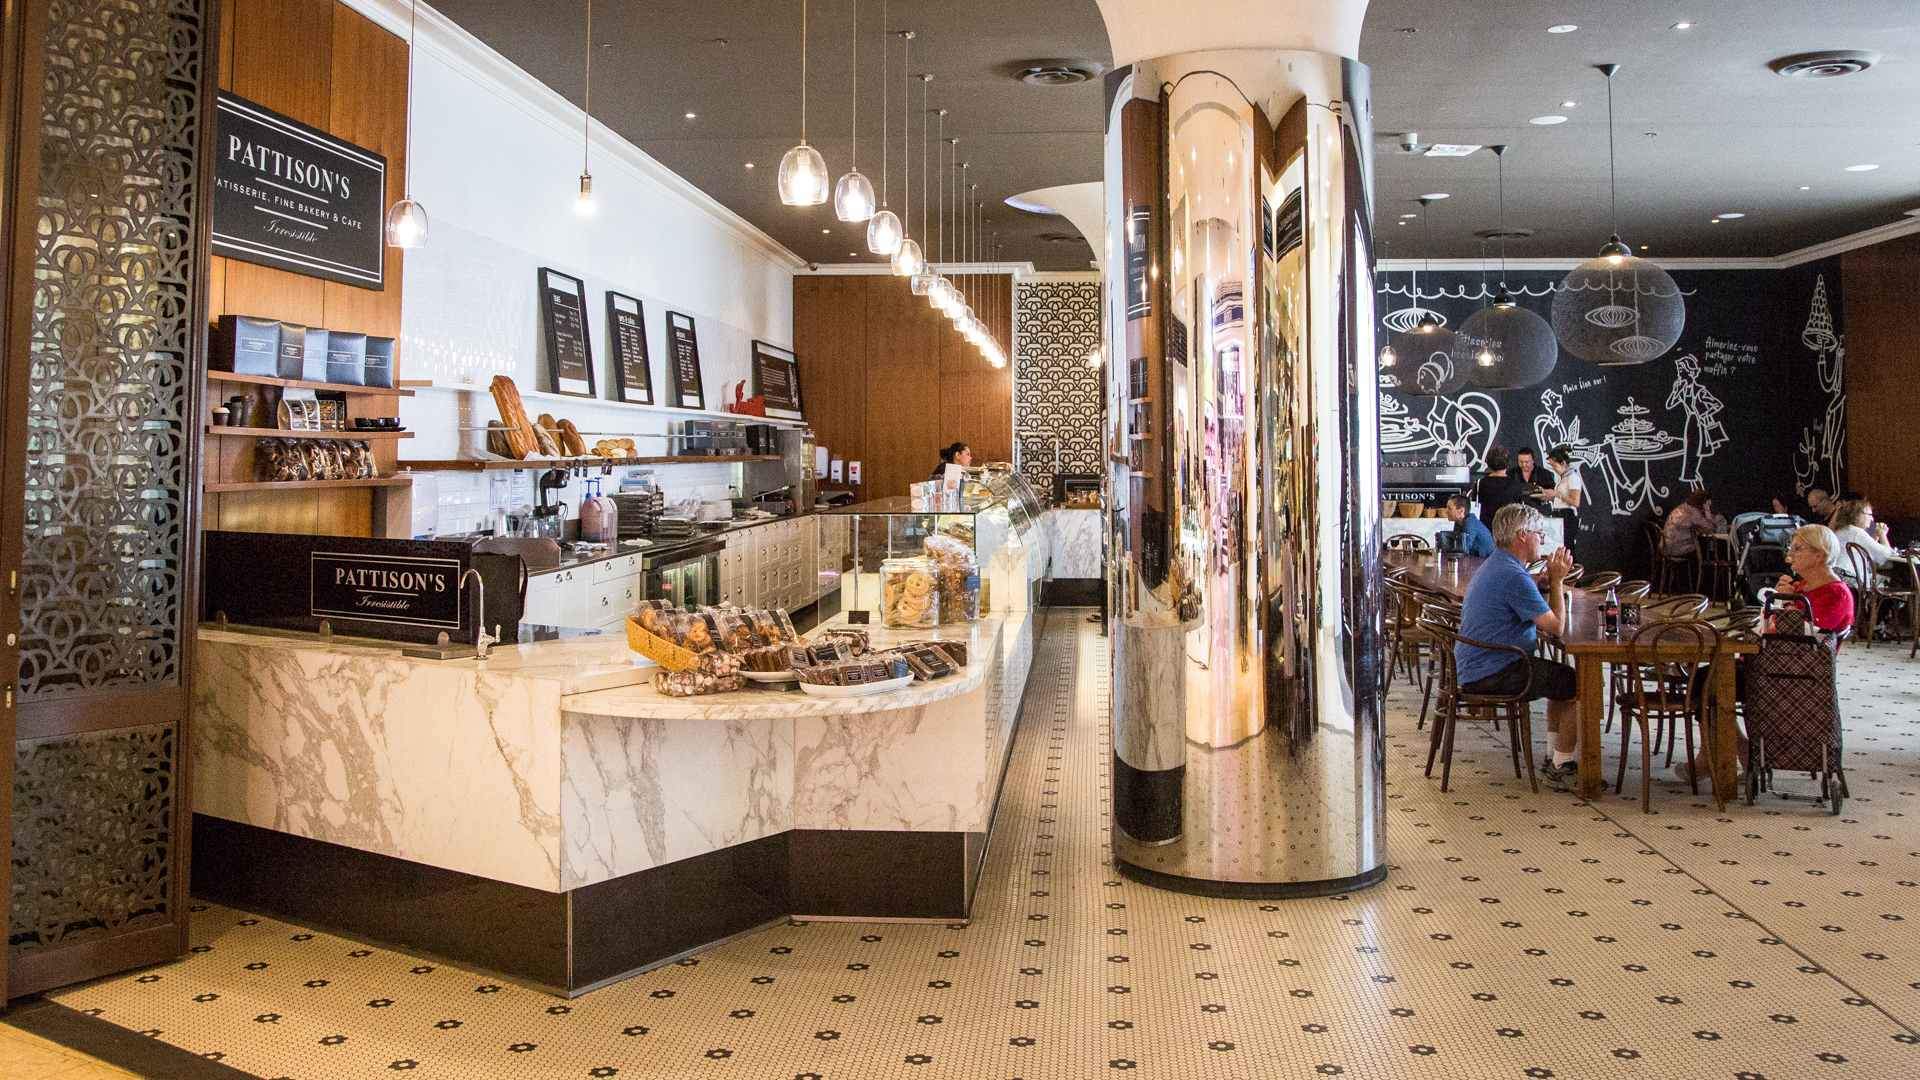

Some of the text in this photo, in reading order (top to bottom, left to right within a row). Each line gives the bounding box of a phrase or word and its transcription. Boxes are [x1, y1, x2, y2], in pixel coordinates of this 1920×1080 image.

[228, 134, 351, 200] PATTISON'S
[275, 195, 295, 209] FINE
[298, 203, 330, 220] BAKERY
[333, 213, 339, 222] &
[1382, 493, 1436, 501] ATTISON'S
[335, 567, 446, 593] PATTISON'S
[355, 594, 411, 610] Irresistible
